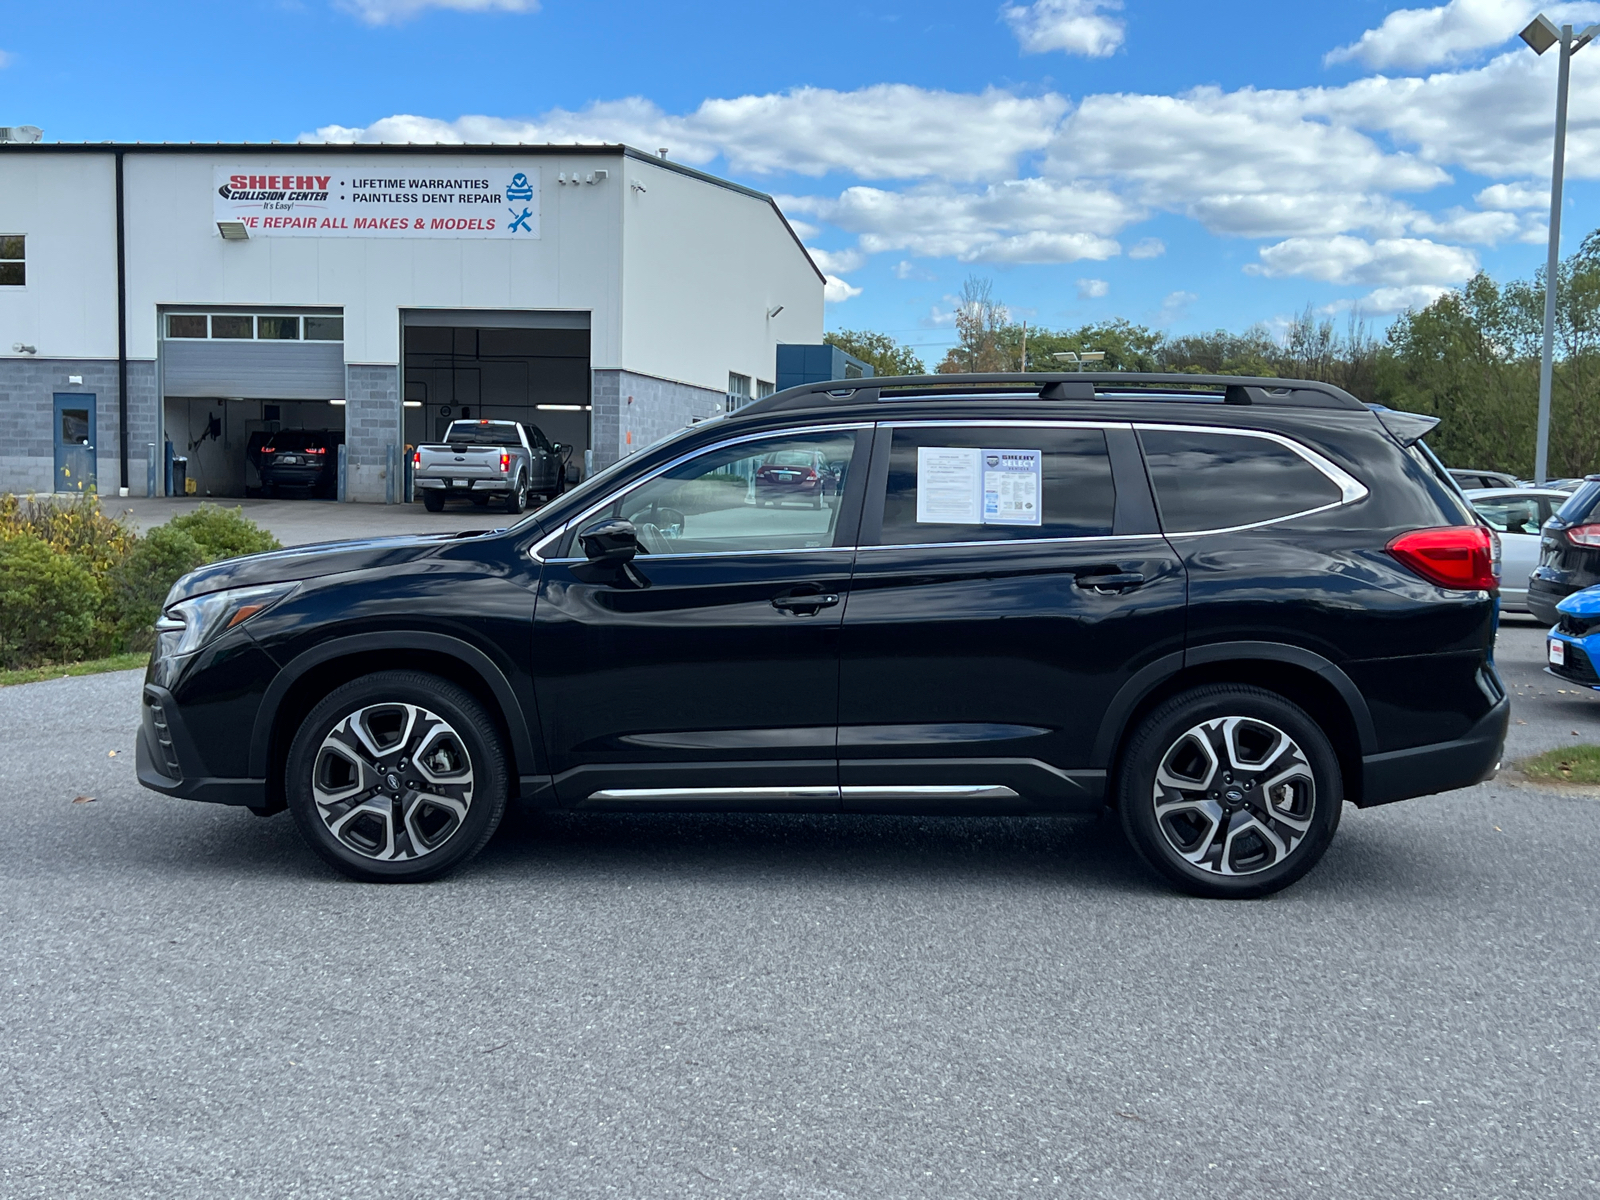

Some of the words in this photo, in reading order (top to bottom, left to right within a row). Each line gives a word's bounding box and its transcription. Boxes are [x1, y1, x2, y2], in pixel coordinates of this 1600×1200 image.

[230, 175, 331, 190] SHEEHY
[352, 179, 406, 188] LIFETIME
[408, 179, 489, 189] WARRANTIES
[230, 191, 286, 200] COLLISION
[288, 191, 329, 201] CENTER
[352, 193, 418, 203] PAINTLESS
[422, 194, 455, 203] DENT
[458, 194, 502, 204] REPAIR
[263, 202, 274, 210] It's
[275, 202, 294, 212] Easy!
[263, 217, 318, 228] REPAIR
[320, 218, 348, 229] ALL
[353, 218, 409, 230] MAKES
[414, 218, 426, 230] &
[430, 218, 496, 230] MODELS
